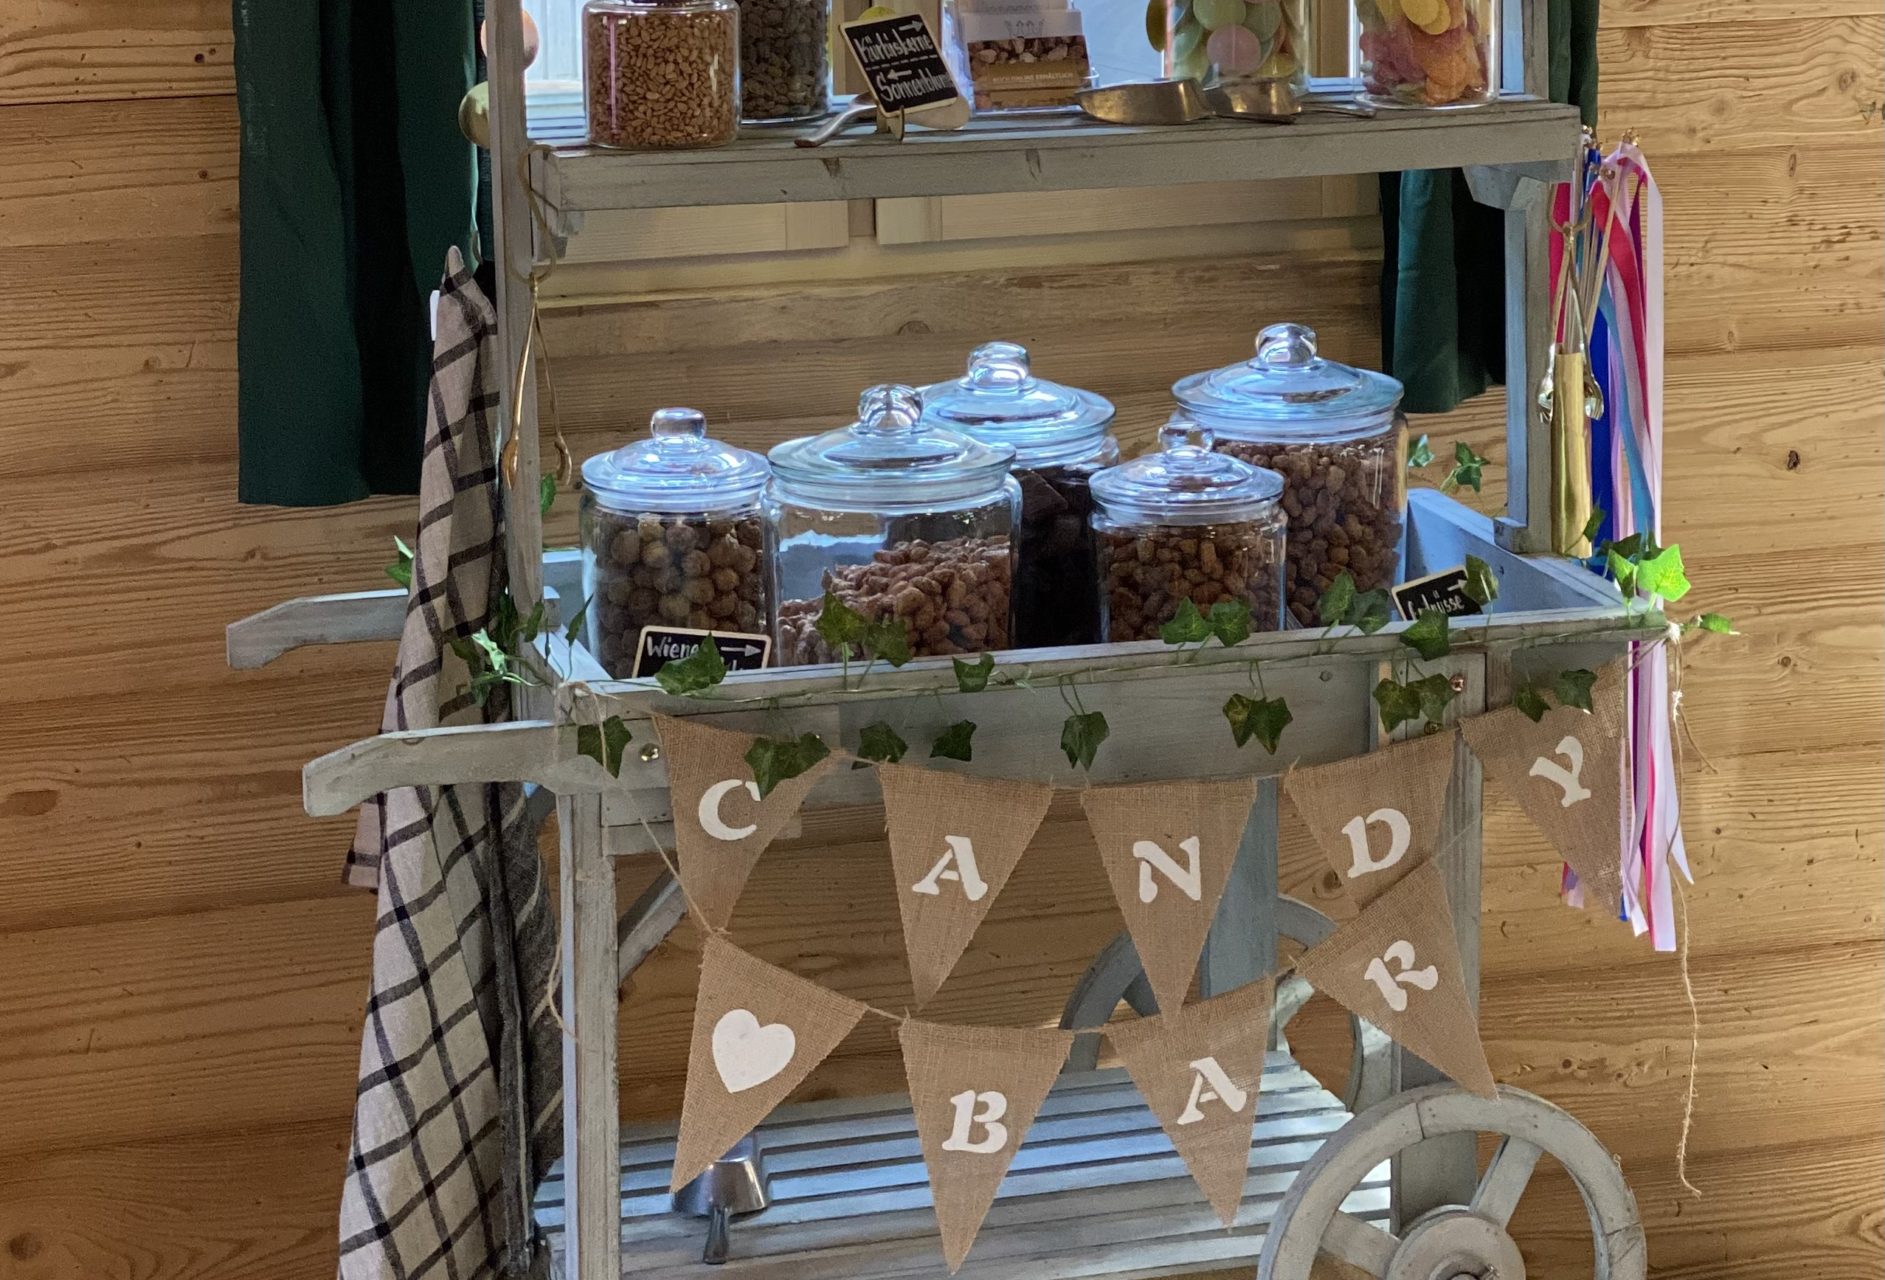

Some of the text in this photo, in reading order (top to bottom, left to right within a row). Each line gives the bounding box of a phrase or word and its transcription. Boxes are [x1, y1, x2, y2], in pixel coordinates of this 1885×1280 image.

[854, 28, 933, 64] Kürbiskerne
[646, 636, 700, 659] Wiene
[699, 735, 1591, 903] CANDY
[942, 940, 1438, 1153] BAR
